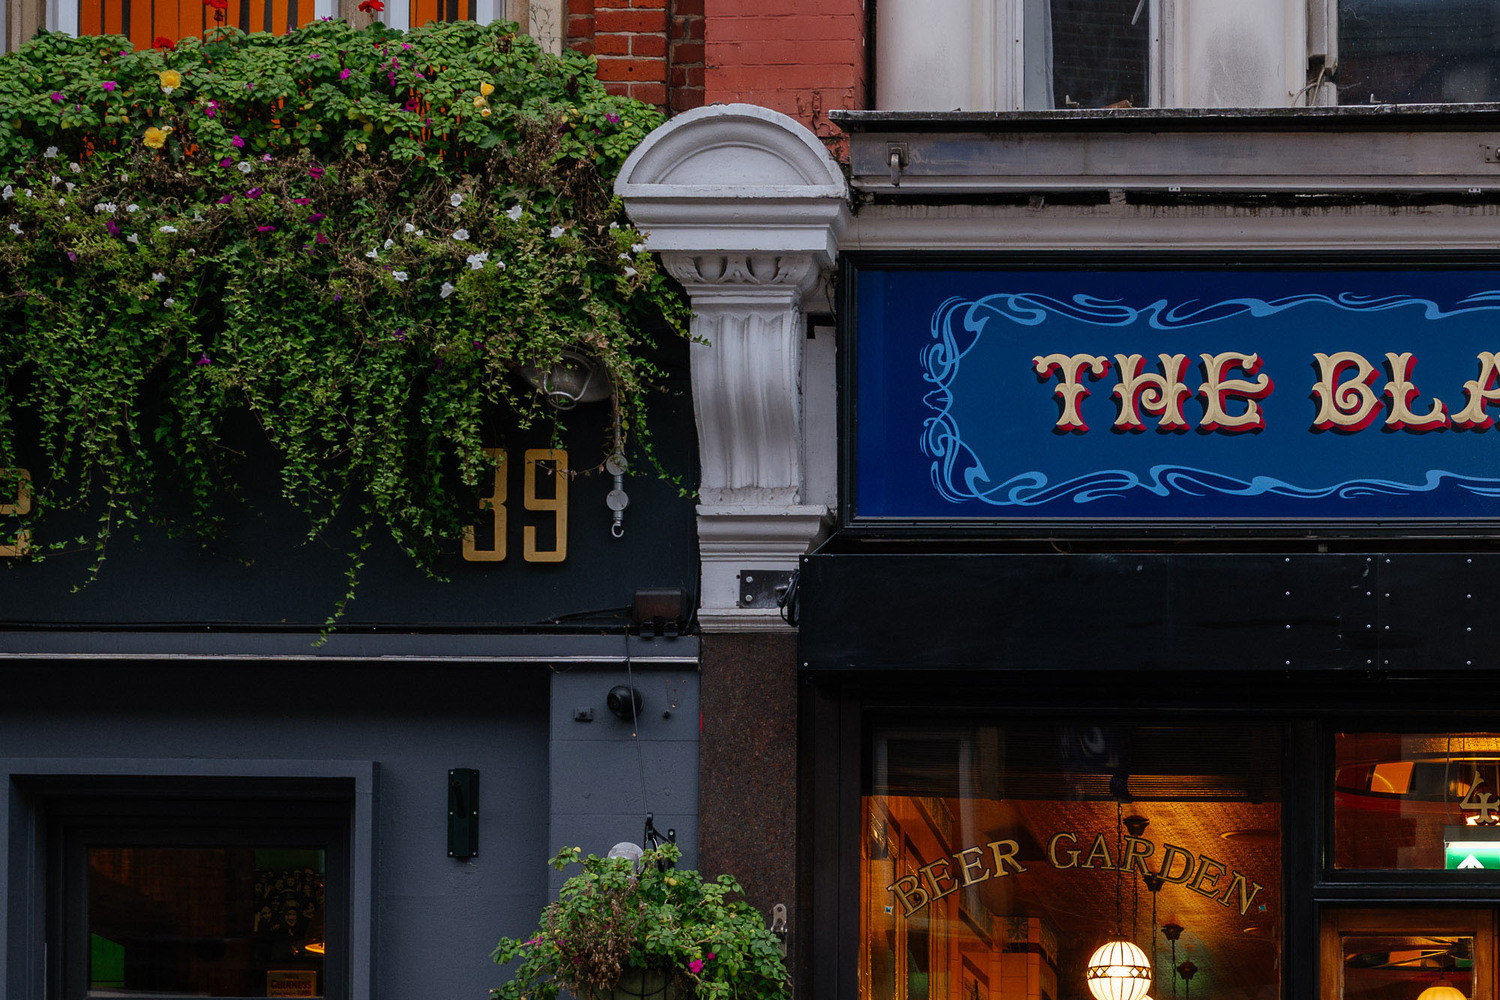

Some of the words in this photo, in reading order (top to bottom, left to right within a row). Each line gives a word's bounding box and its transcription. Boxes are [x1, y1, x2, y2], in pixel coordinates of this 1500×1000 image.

[1031, 350, 1274, 434] THE
[462, 448, 568, 564] 39
[886, 838, 1028, 917] BEER
[1047, 831, 1263, 916] GARDEN
